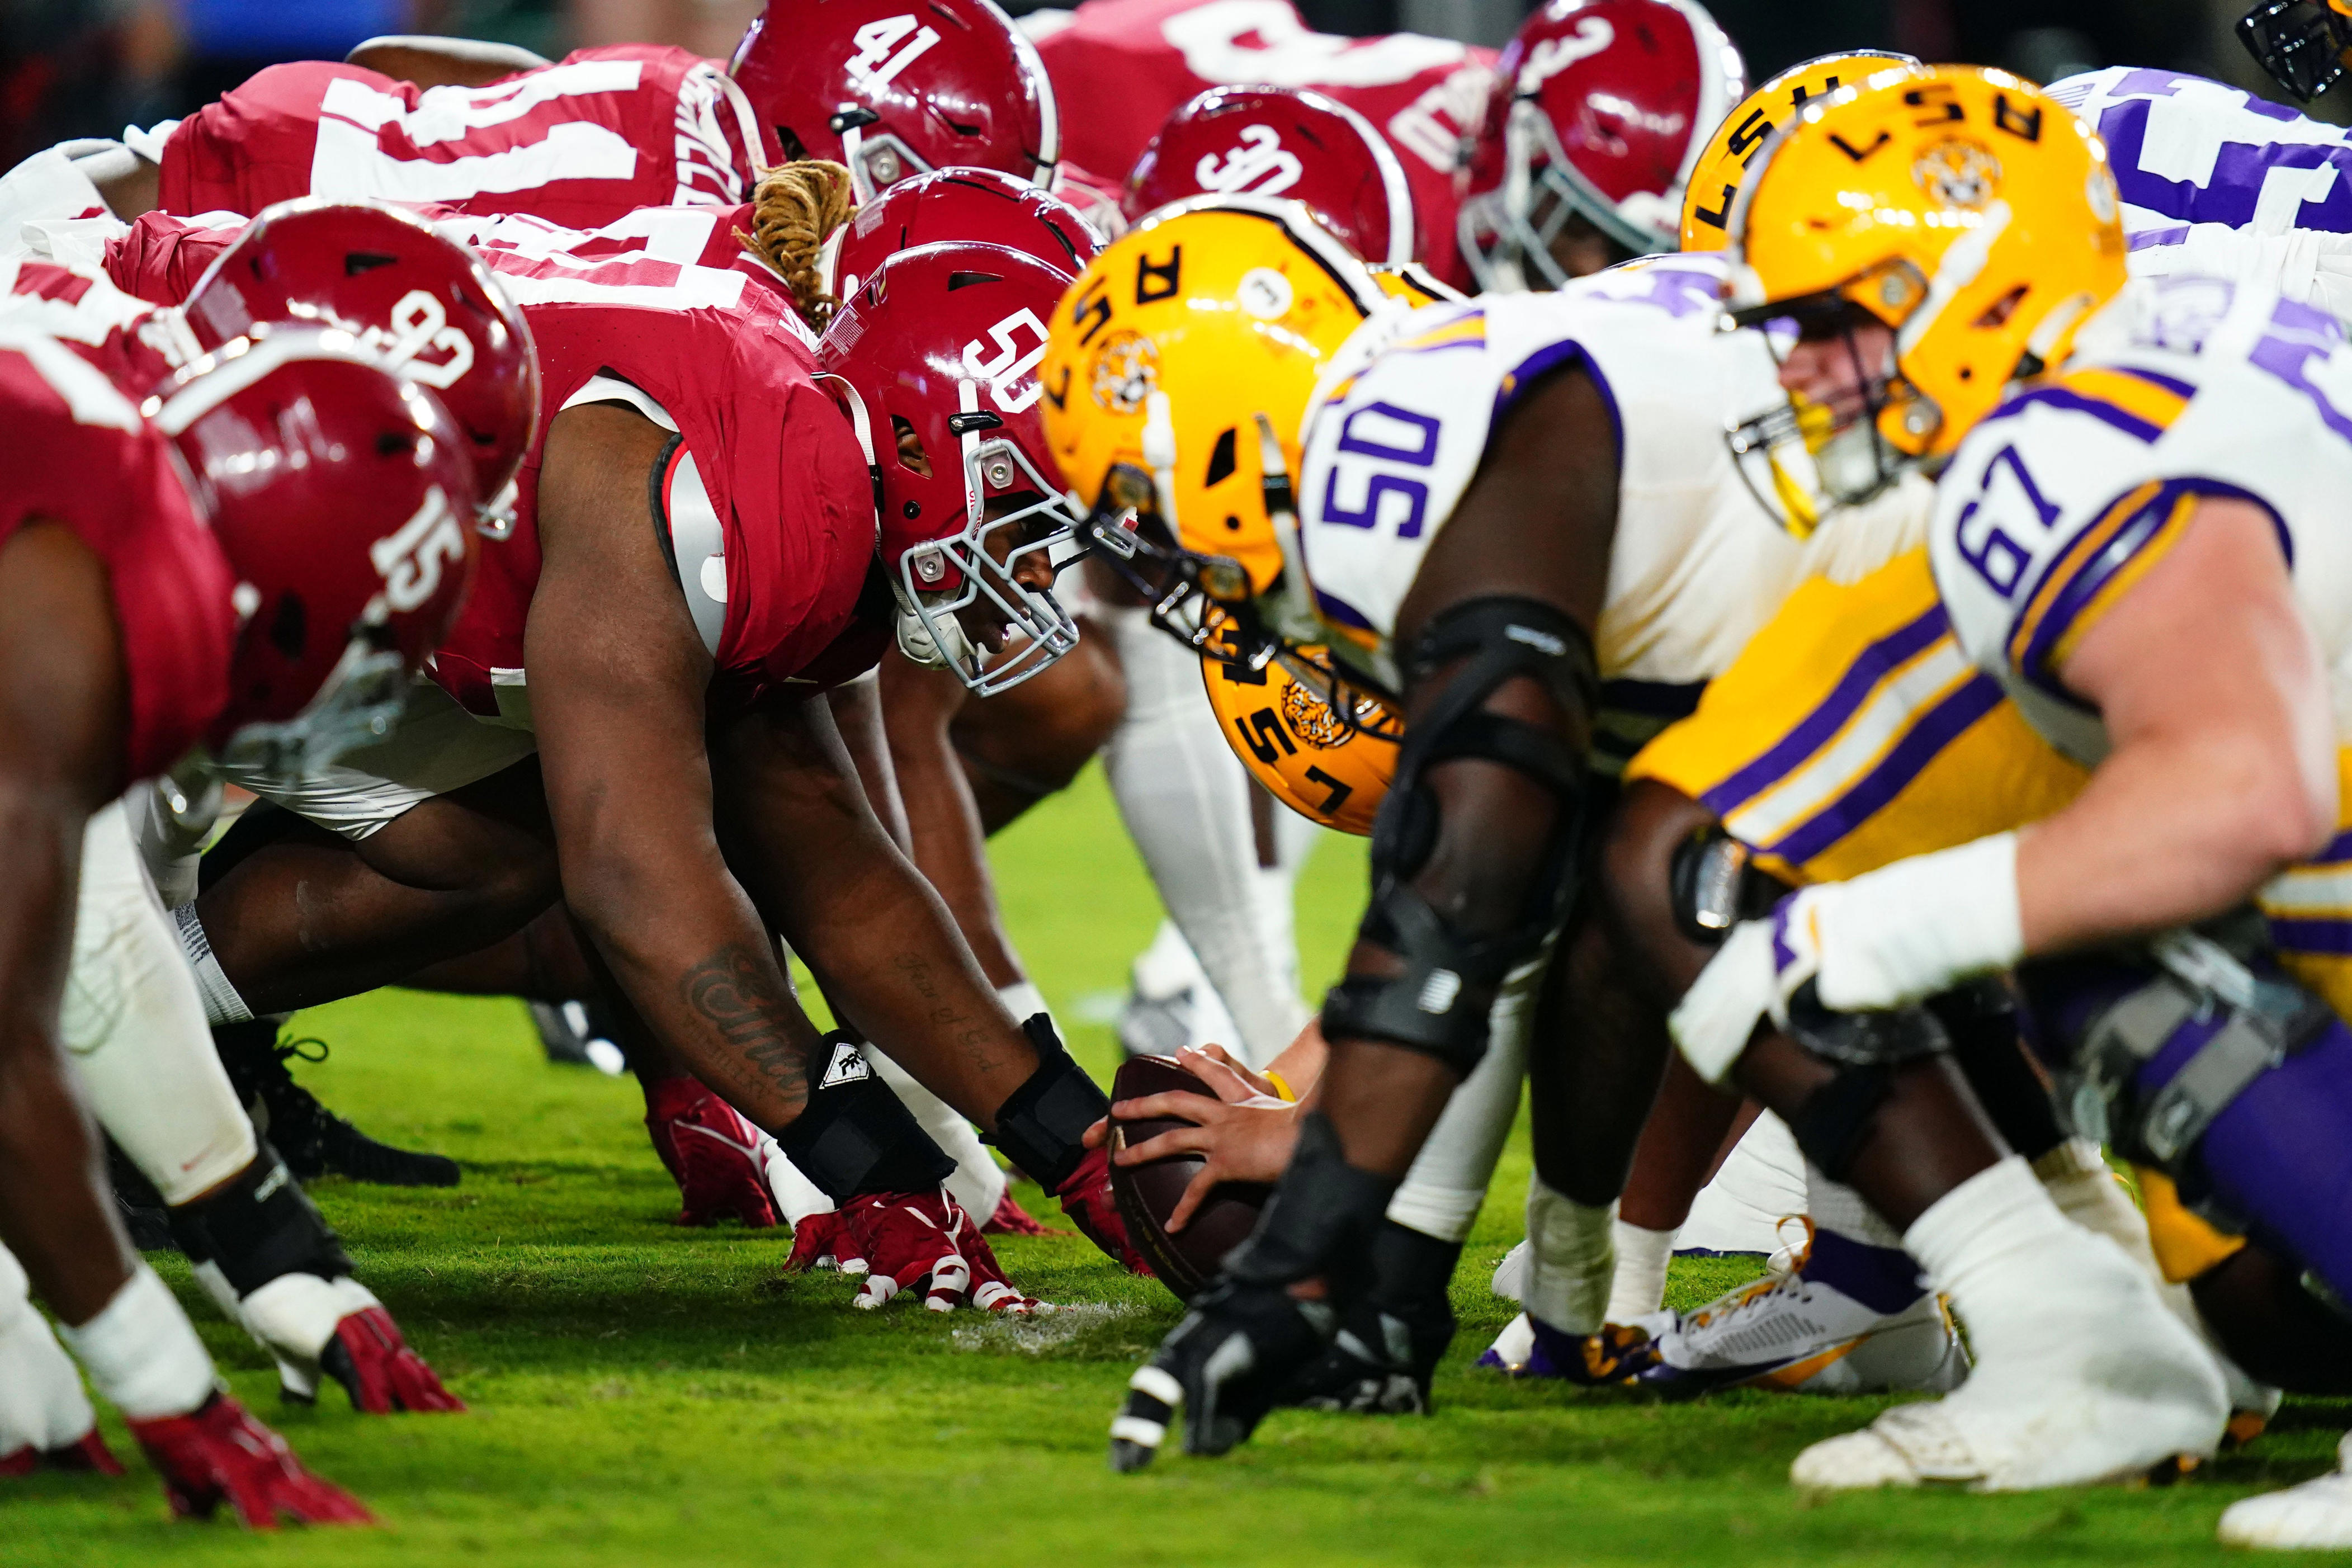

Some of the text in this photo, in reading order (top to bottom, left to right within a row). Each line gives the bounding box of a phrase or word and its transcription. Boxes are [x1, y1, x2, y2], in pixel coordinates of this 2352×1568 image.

[844, 13, 942, 103] 41
[1195, 124, 1303, 197] 30
[1827, 84, 2042, 162] LSU
[962, 306, 1050, 414] 50
[1044, 245, 1182, 411] LSU
[1323, 401, 1440, 539] 50
[1956, 445, 2062, 598] 67
[369, 482, 466, 613] 15
[839, 1050, 865, 1077] PRO
